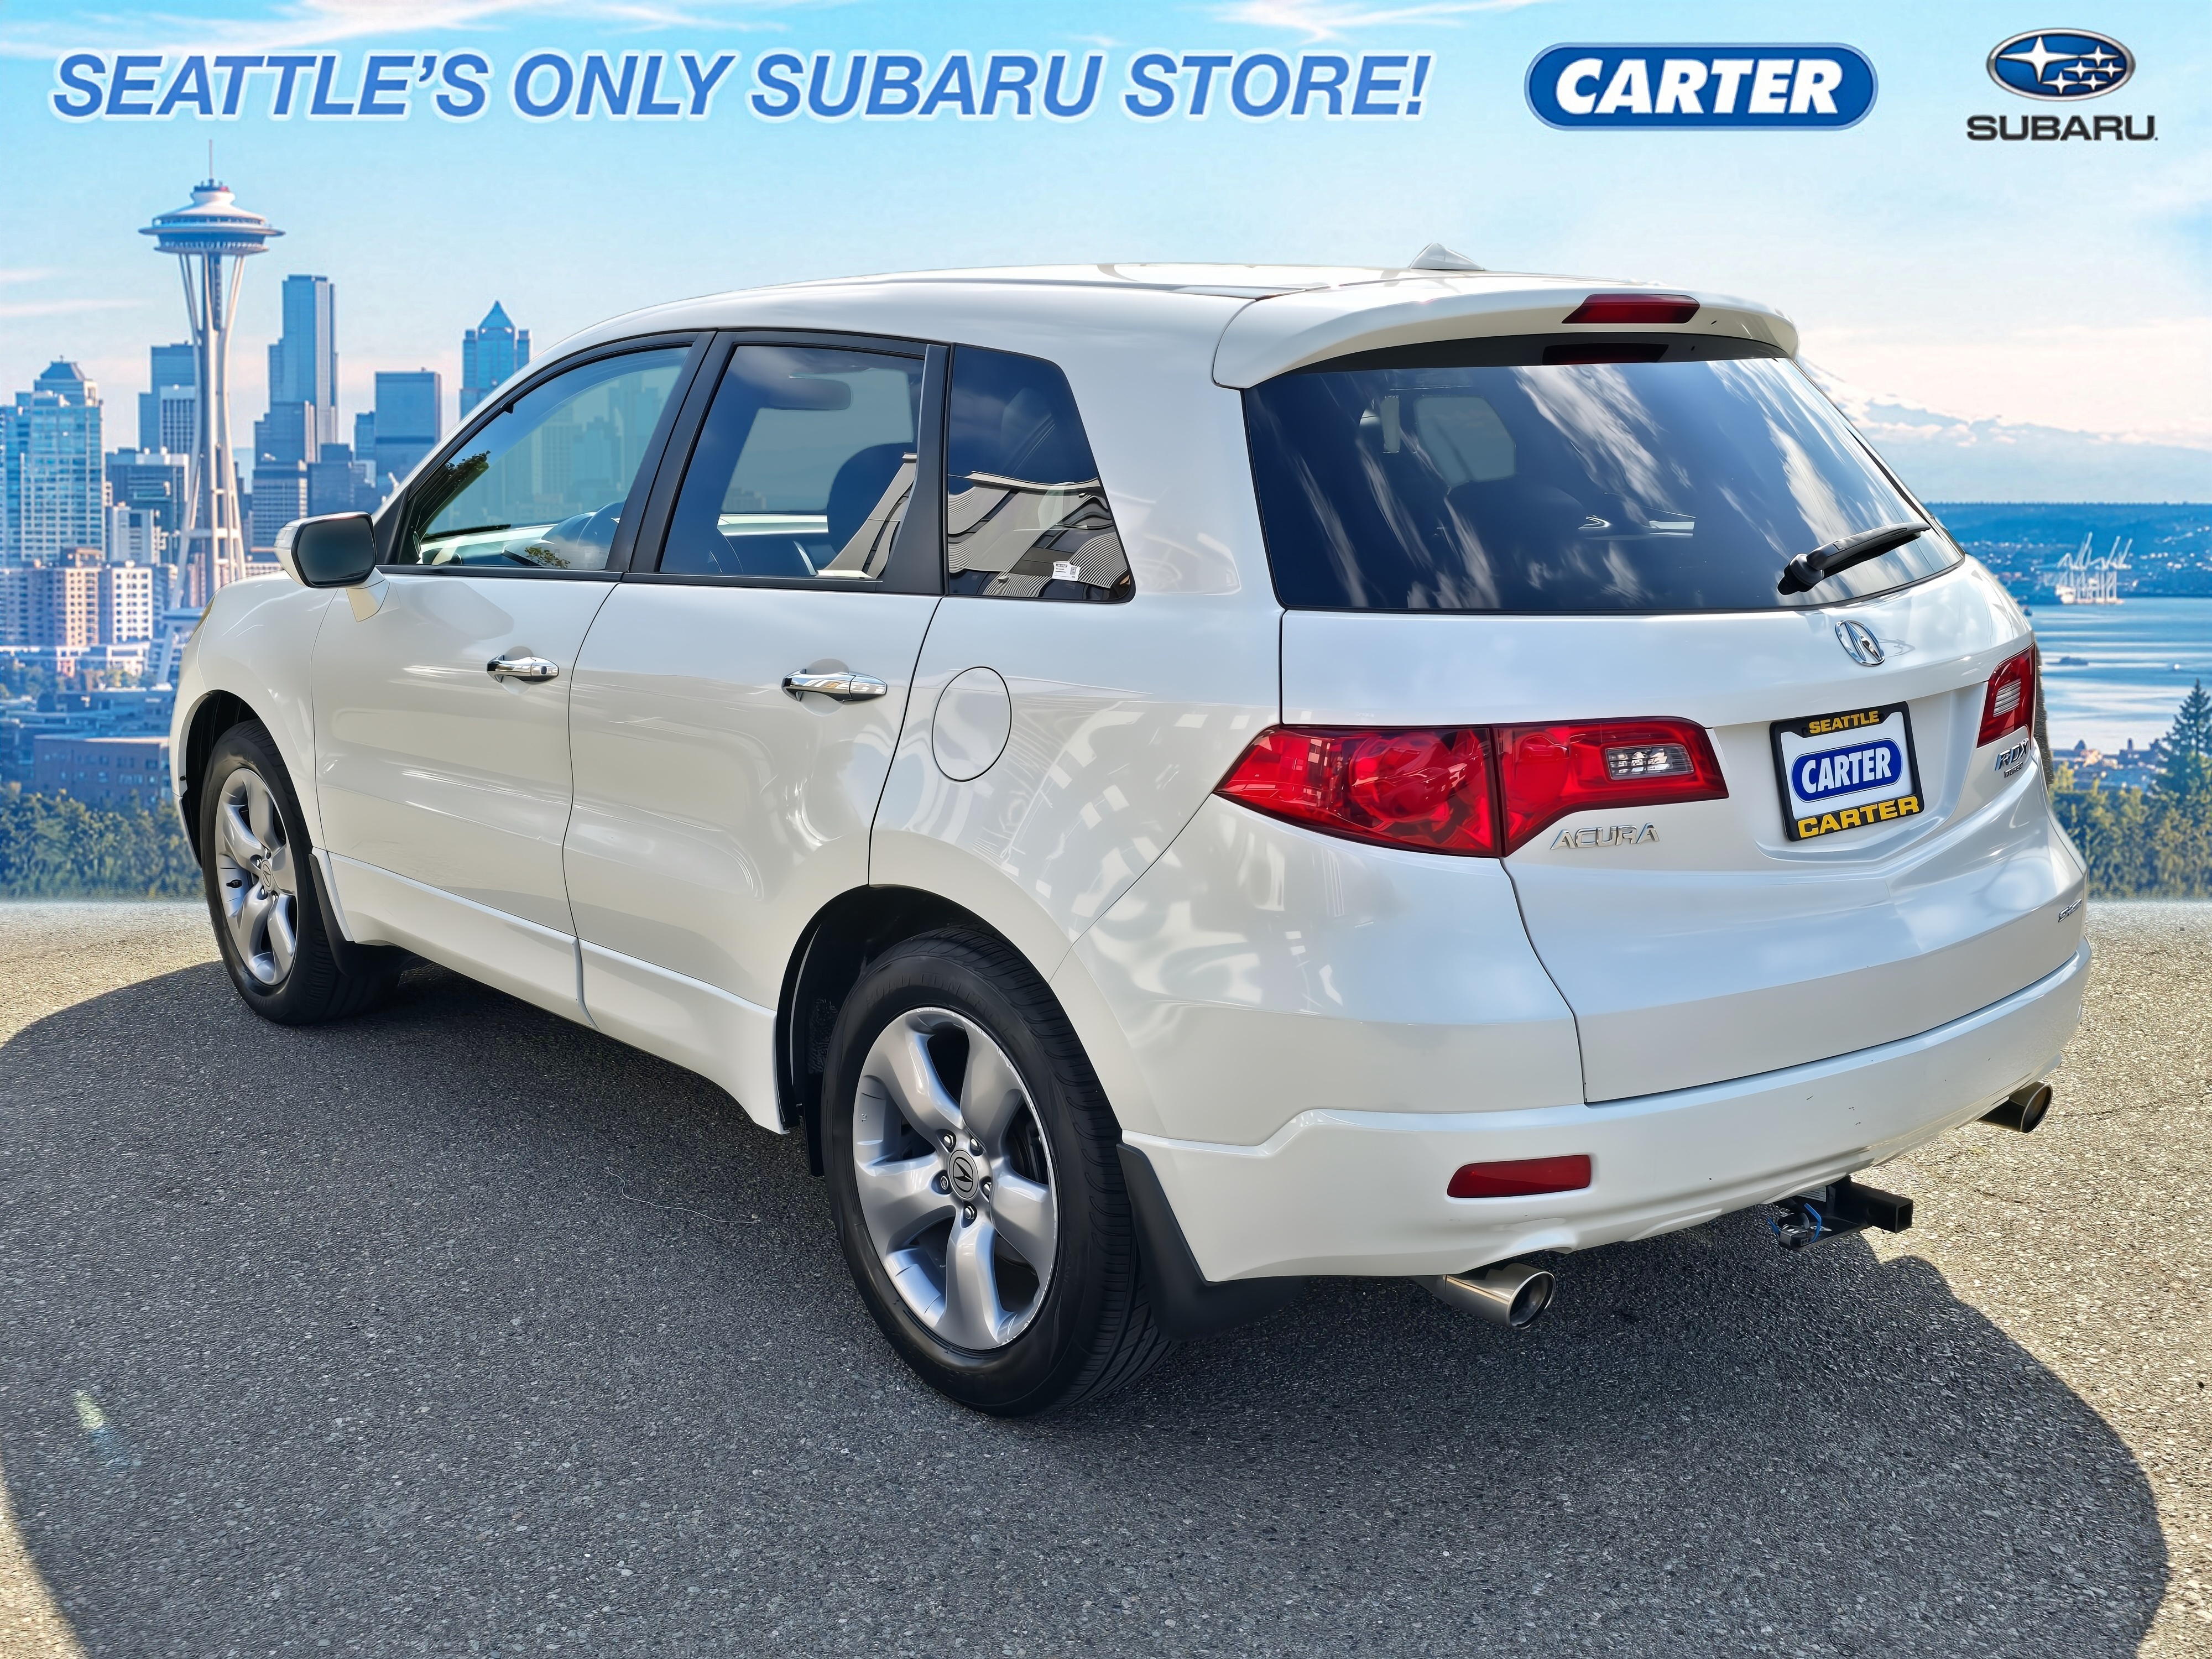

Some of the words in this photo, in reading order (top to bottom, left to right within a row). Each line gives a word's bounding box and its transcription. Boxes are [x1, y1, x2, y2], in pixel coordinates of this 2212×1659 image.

[1809, 711, 1879, 734] SEATTLE
[1801, 747, 1892, 794] CARTER
[1994, 738, 2029, 771] RDX
[1797, 796, 1919, 838] CARTER
[1550, 822, 1660, 850] ACURA
